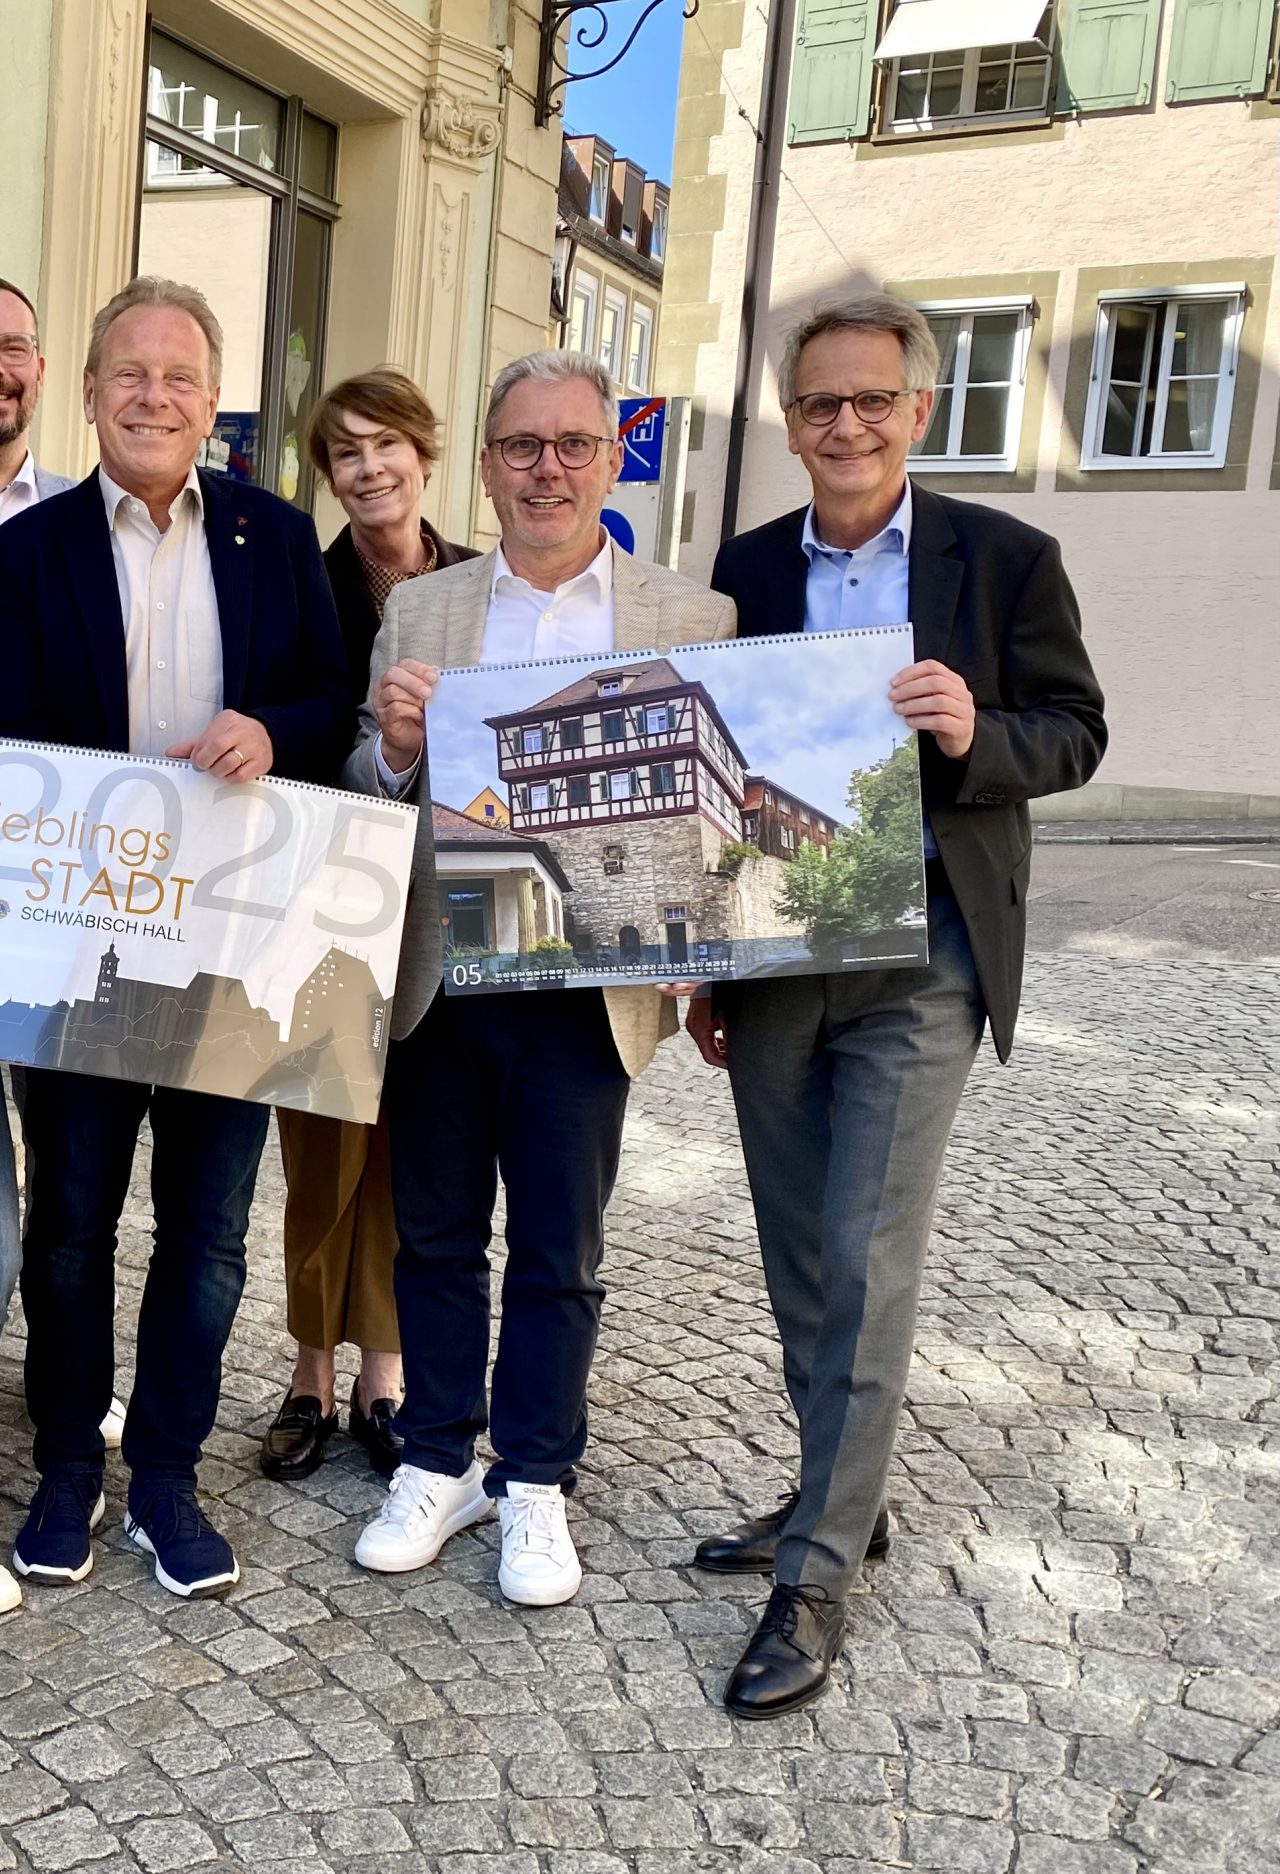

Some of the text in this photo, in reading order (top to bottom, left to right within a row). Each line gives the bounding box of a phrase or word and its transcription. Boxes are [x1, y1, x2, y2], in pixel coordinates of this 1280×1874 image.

[25, 858, 194, 920] STADT
[21, 907, 186, 942] SCHWÄBISCH HALL
[453, 964, 481, 986] 05
[372, 1008, 383, 1047] edition 12
[524, 1486, 550, 1495] adidas
